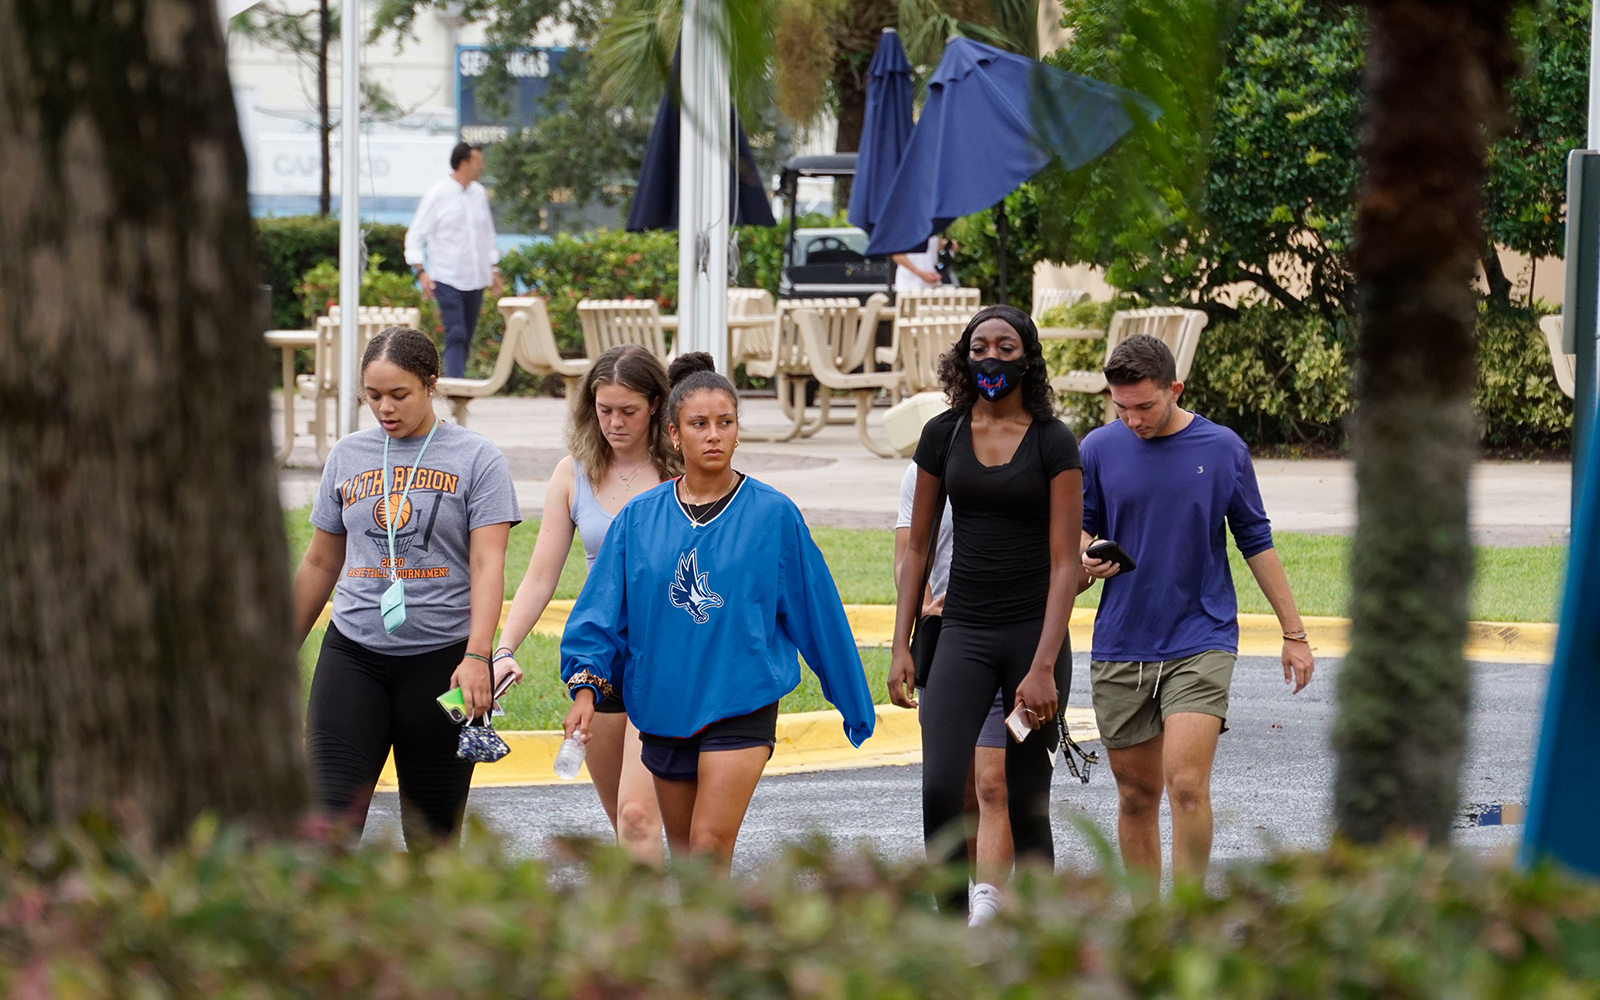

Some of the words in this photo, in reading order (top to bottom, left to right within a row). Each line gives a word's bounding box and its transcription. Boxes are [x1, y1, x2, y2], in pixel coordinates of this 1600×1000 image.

[391, 465, 459, 495] REGION
[380, 557, 405, 568] 2020
[347, 567, 389, 579] BASKETBALL
